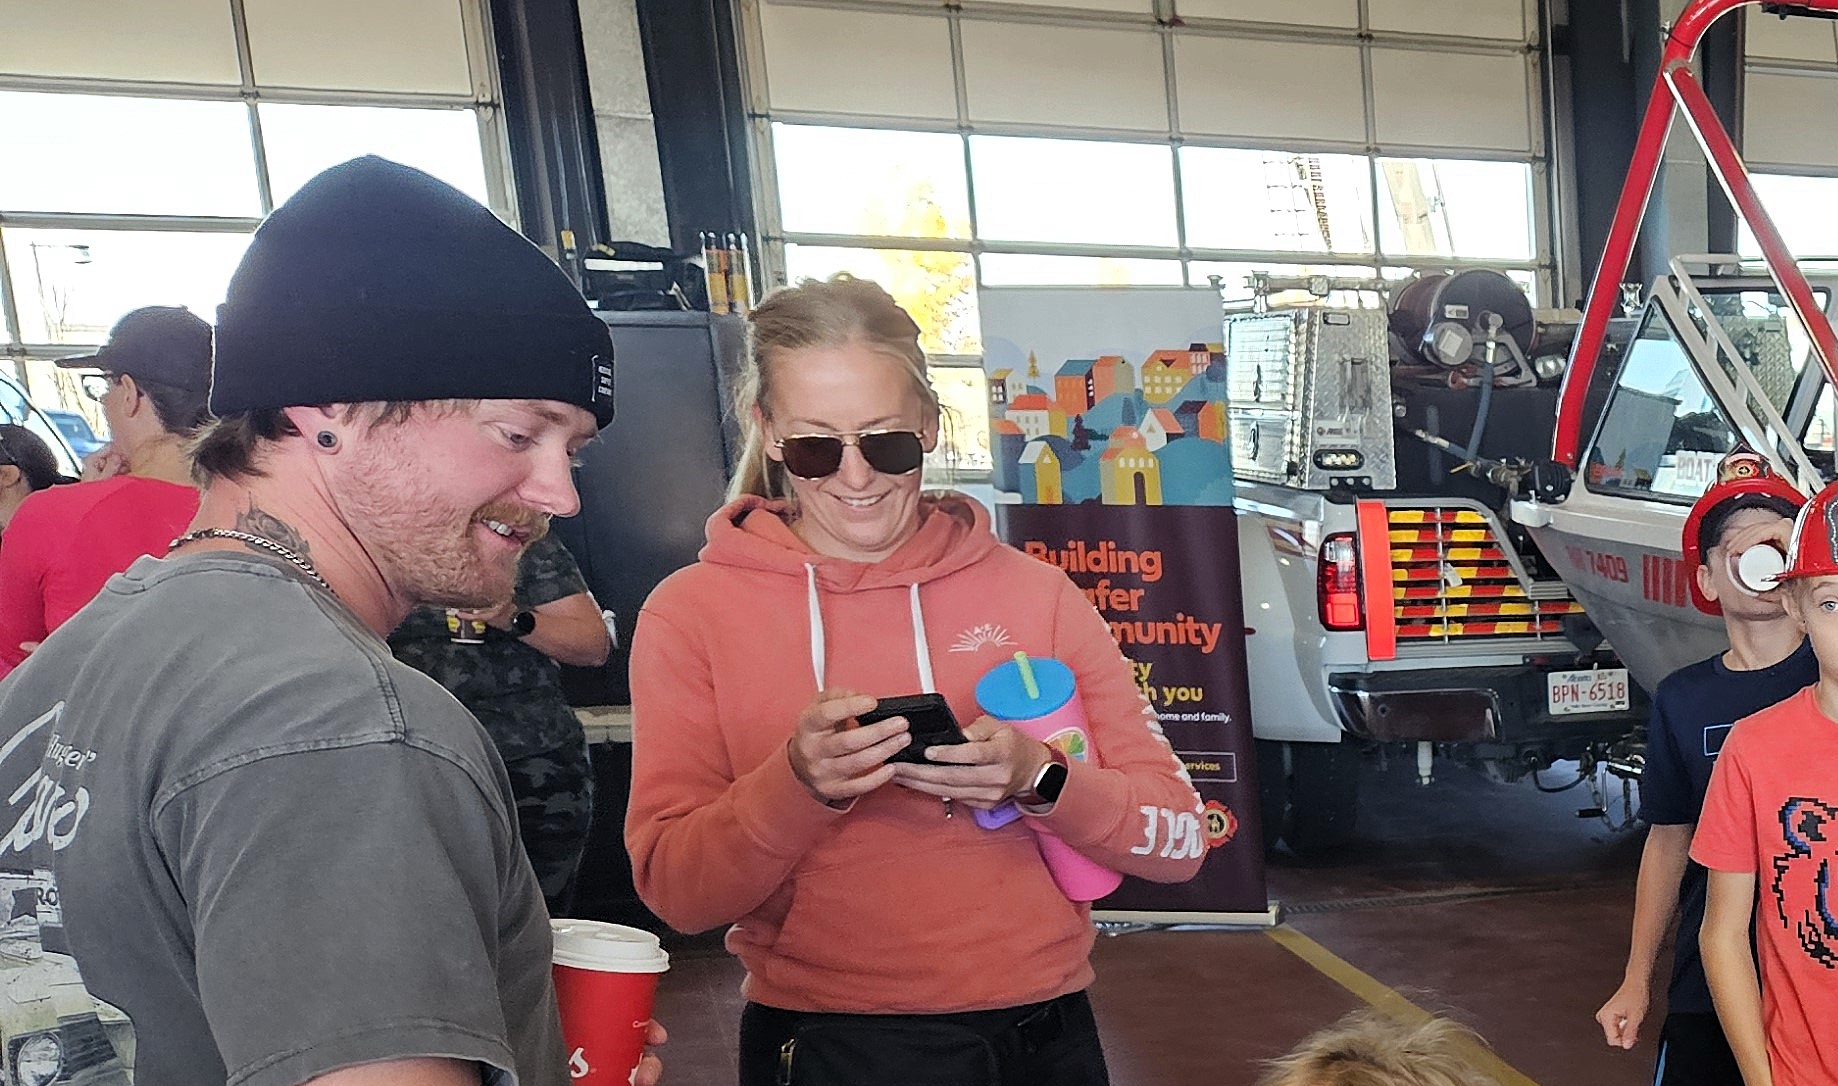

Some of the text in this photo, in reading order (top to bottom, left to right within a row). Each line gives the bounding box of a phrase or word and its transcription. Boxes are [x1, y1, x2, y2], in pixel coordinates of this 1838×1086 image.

[1024, 540, 1163, 582] Building
[1086, 579, 1145, 611] afer
[1110, 612, 1222, 653] munity
[1164, 685, 1204, 706] you
[1553, 682, 1625, 704] BPN-6518
[1182, 711, 1200, 722] and
